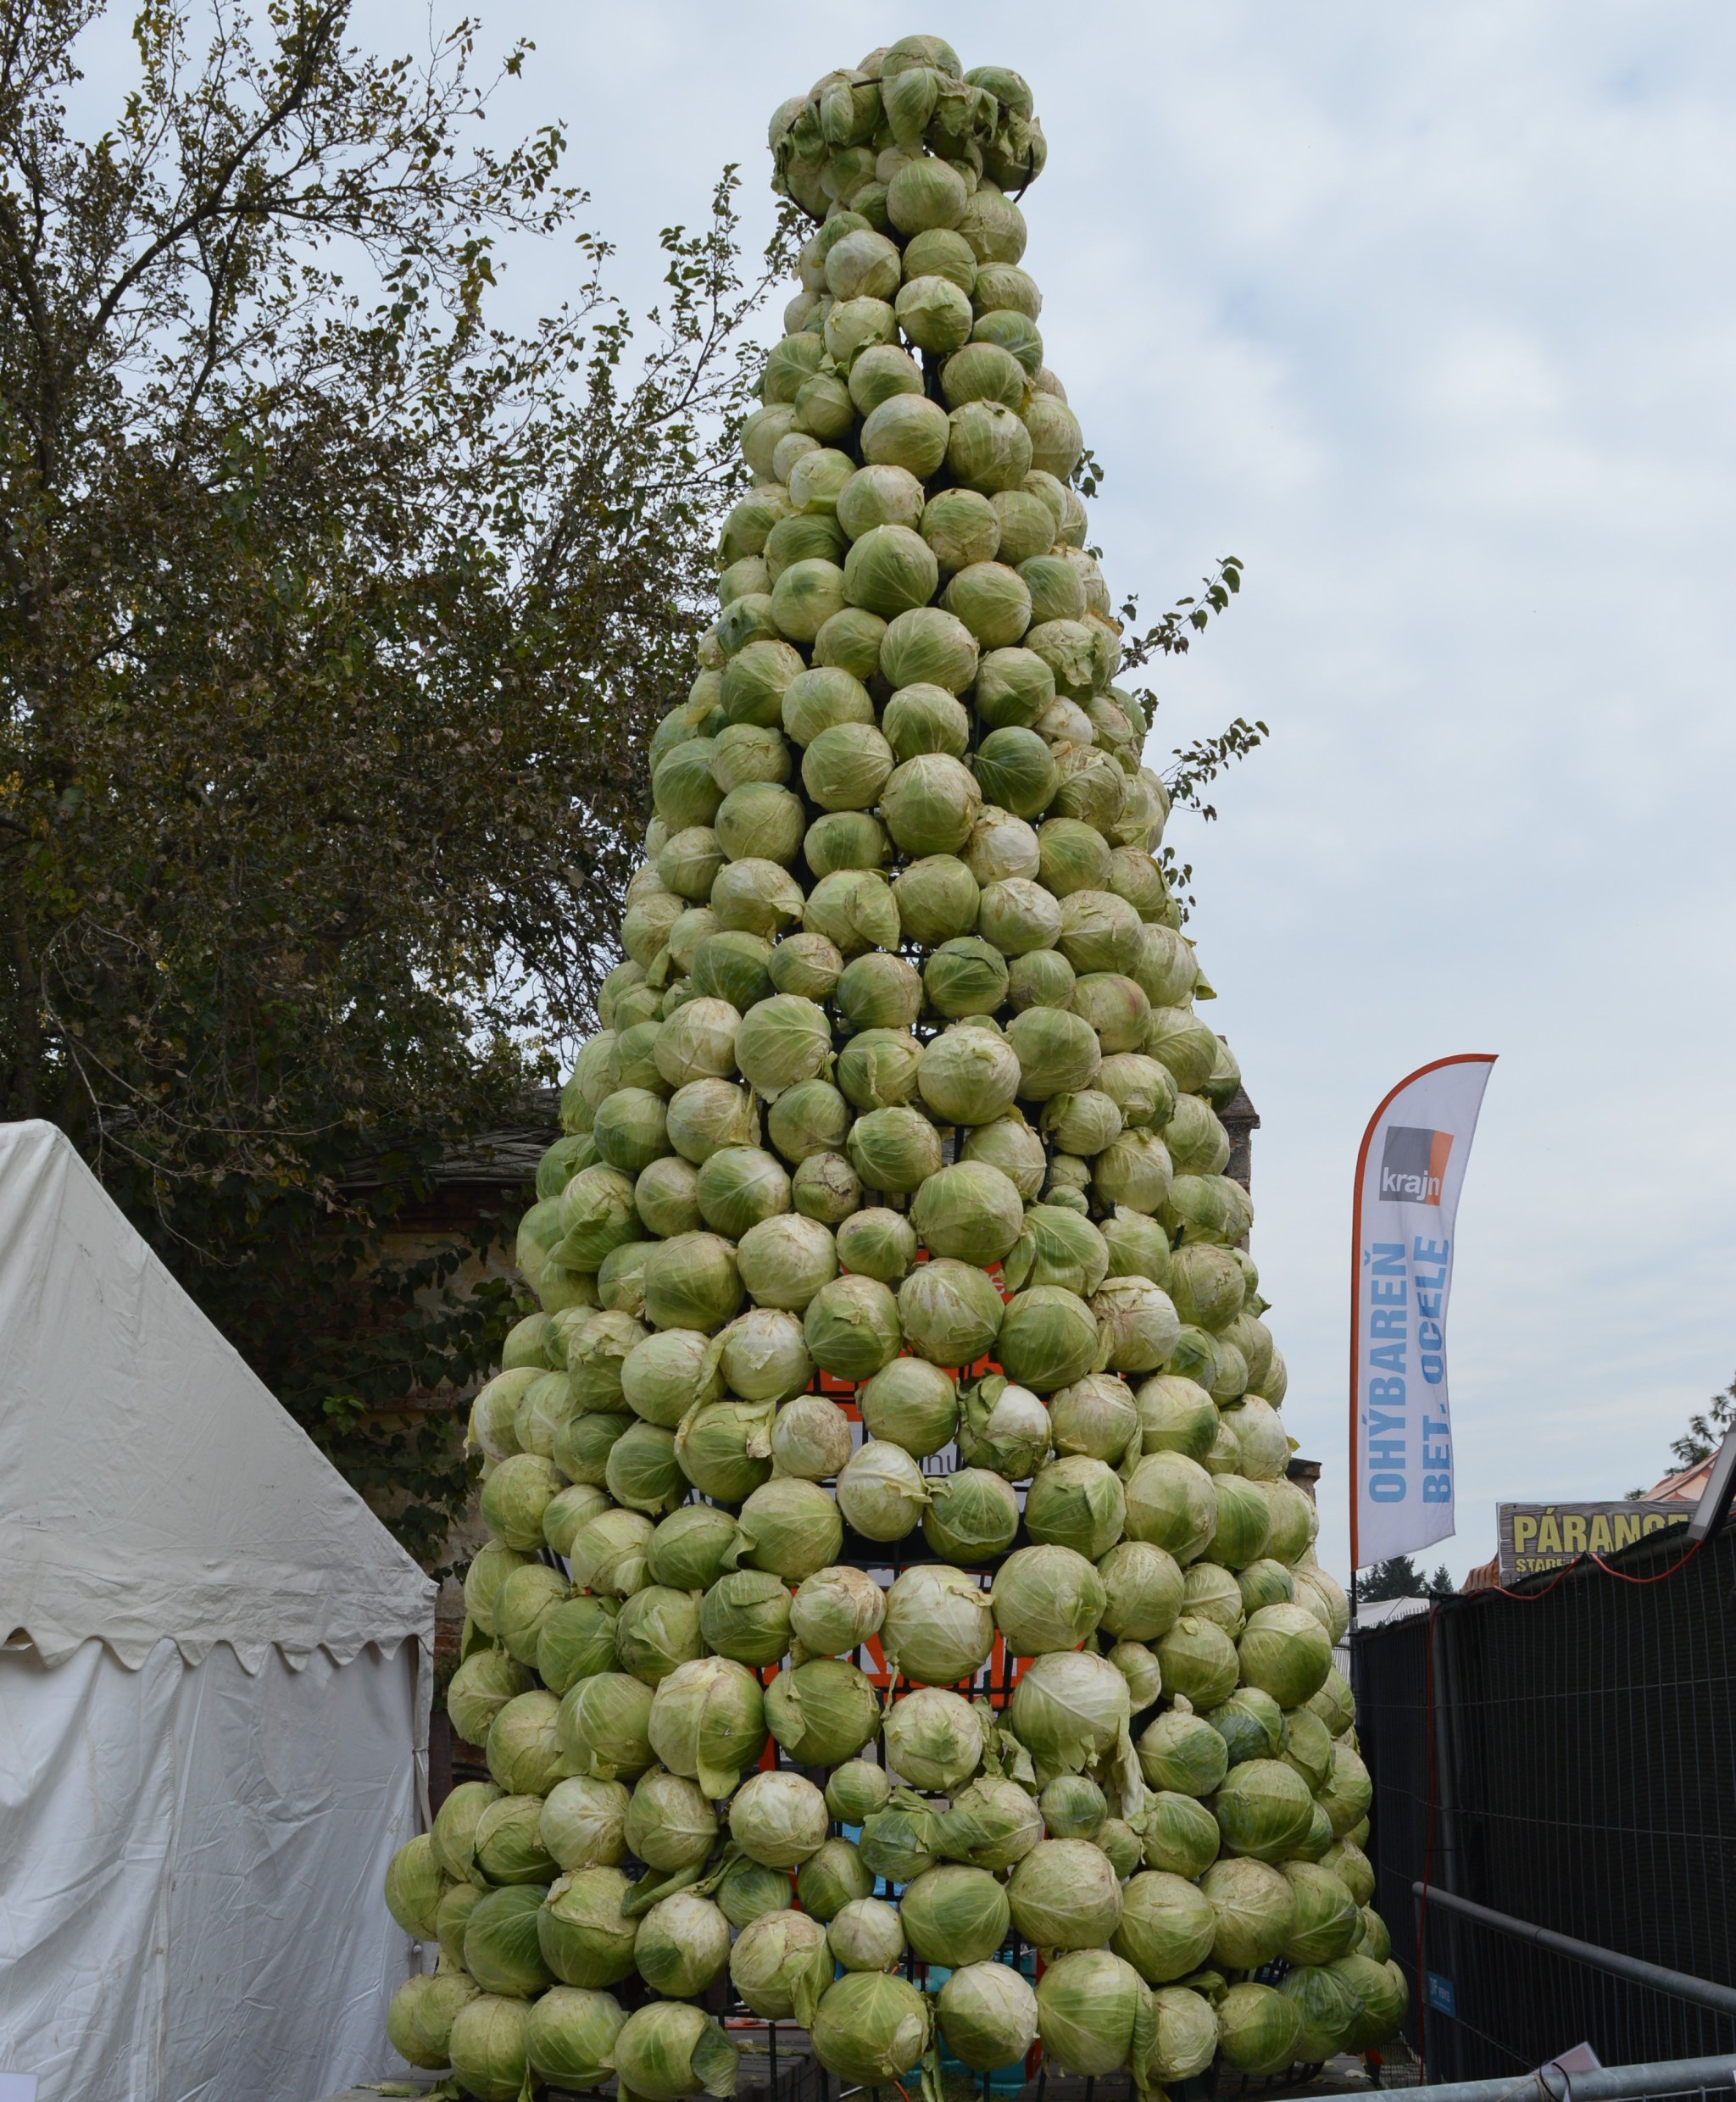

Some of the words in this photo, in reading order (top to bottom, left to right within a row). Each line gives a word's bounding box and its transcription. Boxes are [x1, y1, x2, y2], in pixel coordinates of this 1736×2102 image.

[1383, 1167, 1439, 1200] krajn
[1413, 1236, 1449, 1384] OCELE
[1362, 1243, 1407, 1503] OHÝBAREŇ
[1513, 1507, 1689, 1554] PÁRAN
